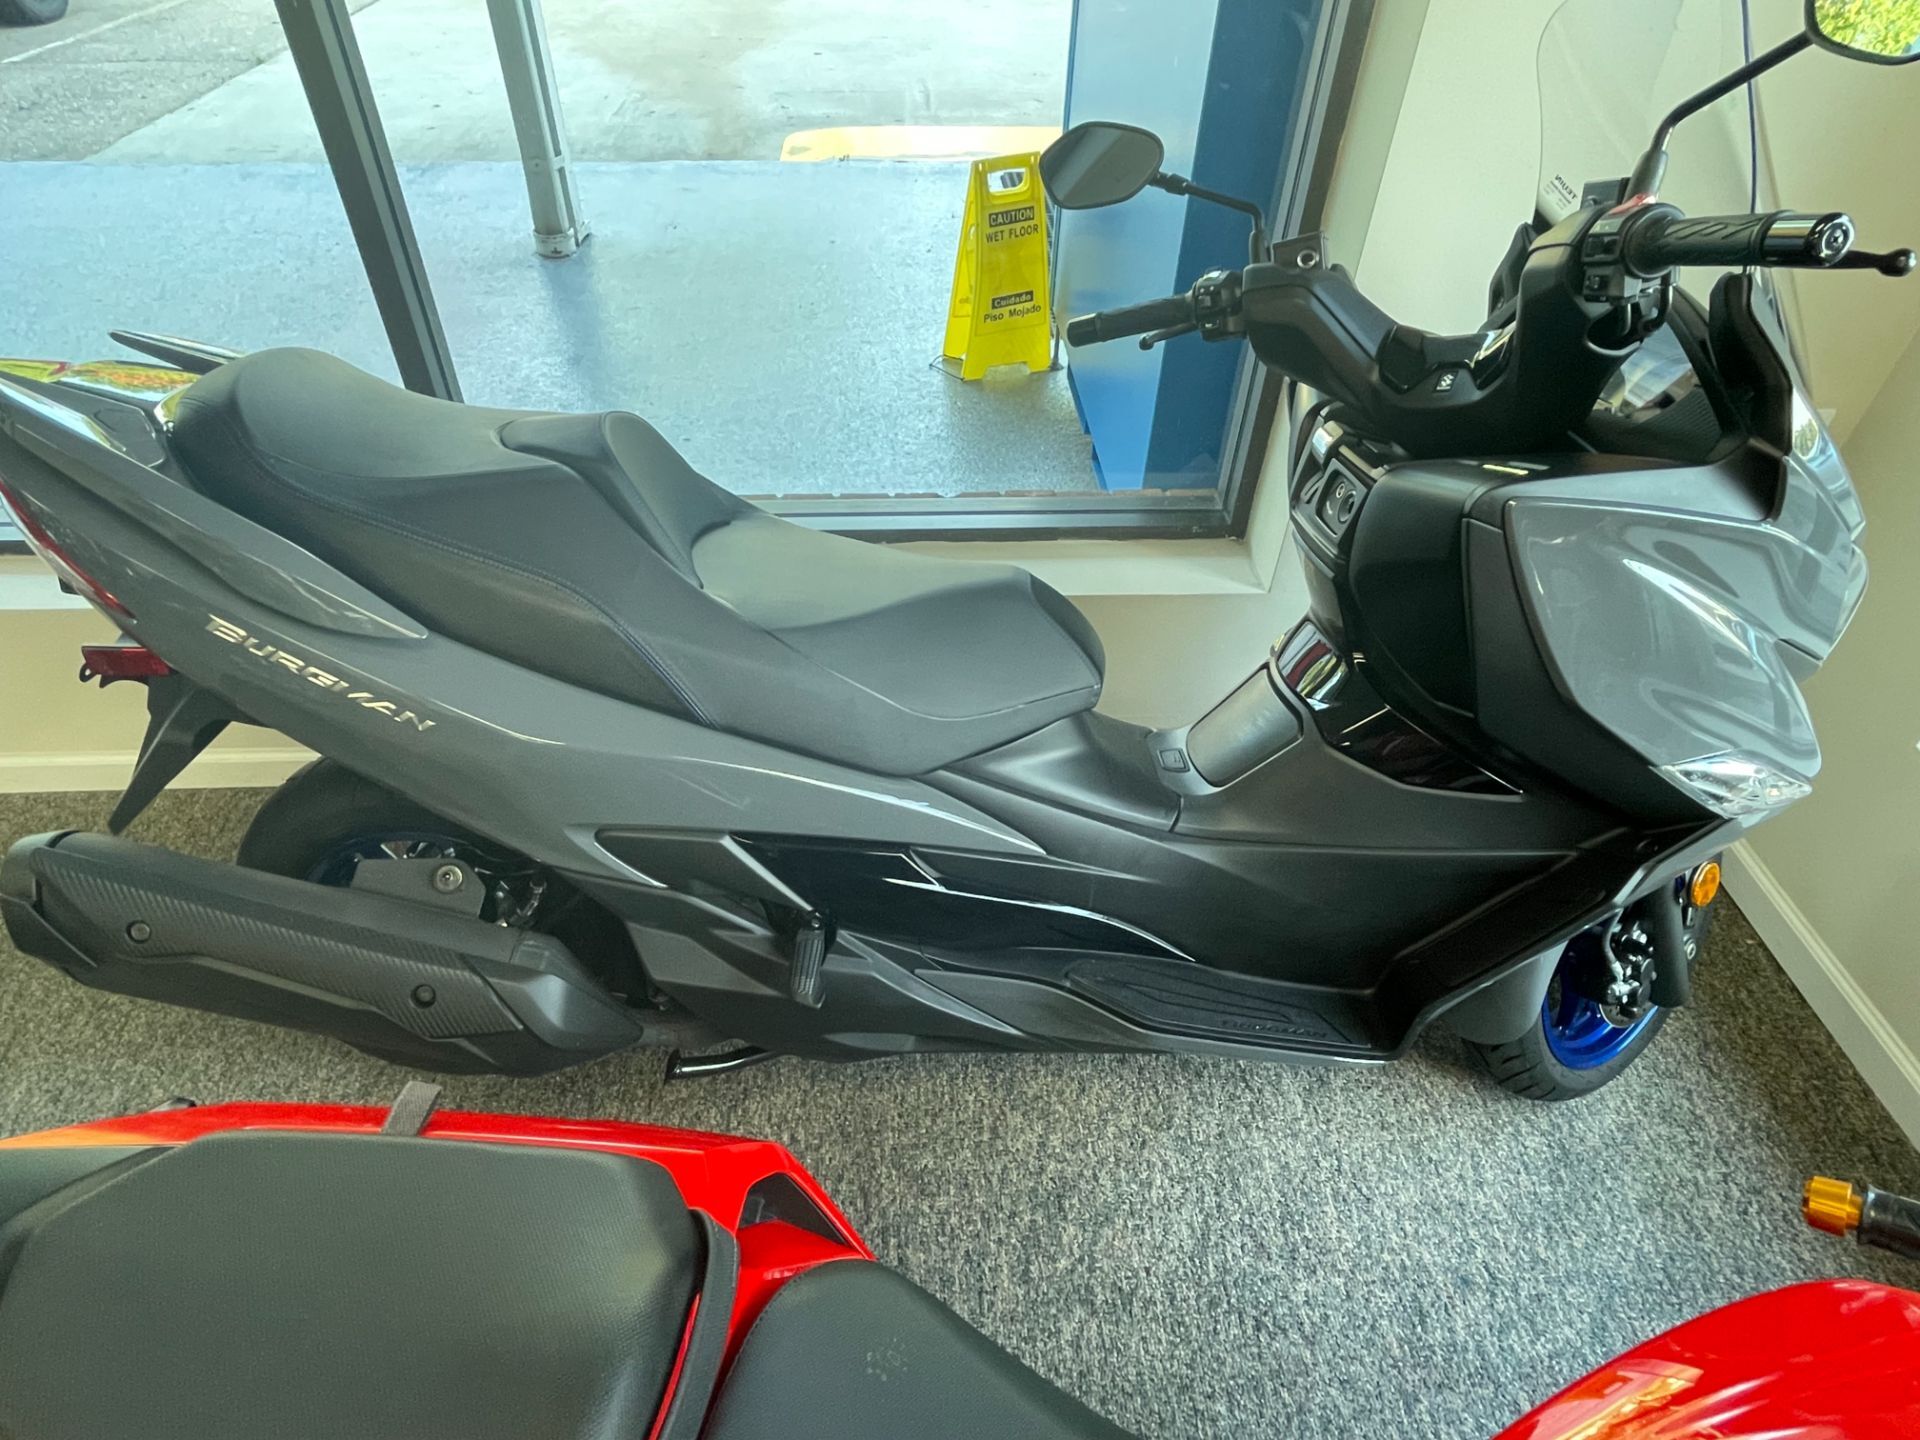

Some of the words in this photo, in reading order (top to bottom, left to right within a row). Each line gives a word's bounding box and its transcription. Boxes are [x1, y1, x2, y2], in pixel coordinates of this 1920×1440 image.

[990, 207, 1034, 226] CAUTION
[985, 230, 1005, 244] WET
[1008, 223, 1039, 240] FLOOR
[993, 294, 1032, 308] Cuidado
[983, 311, 1004, 323] Piso
[1008, 303, 1042, 318] Mojado
[205, 613, 436, 731] BURGMAN
